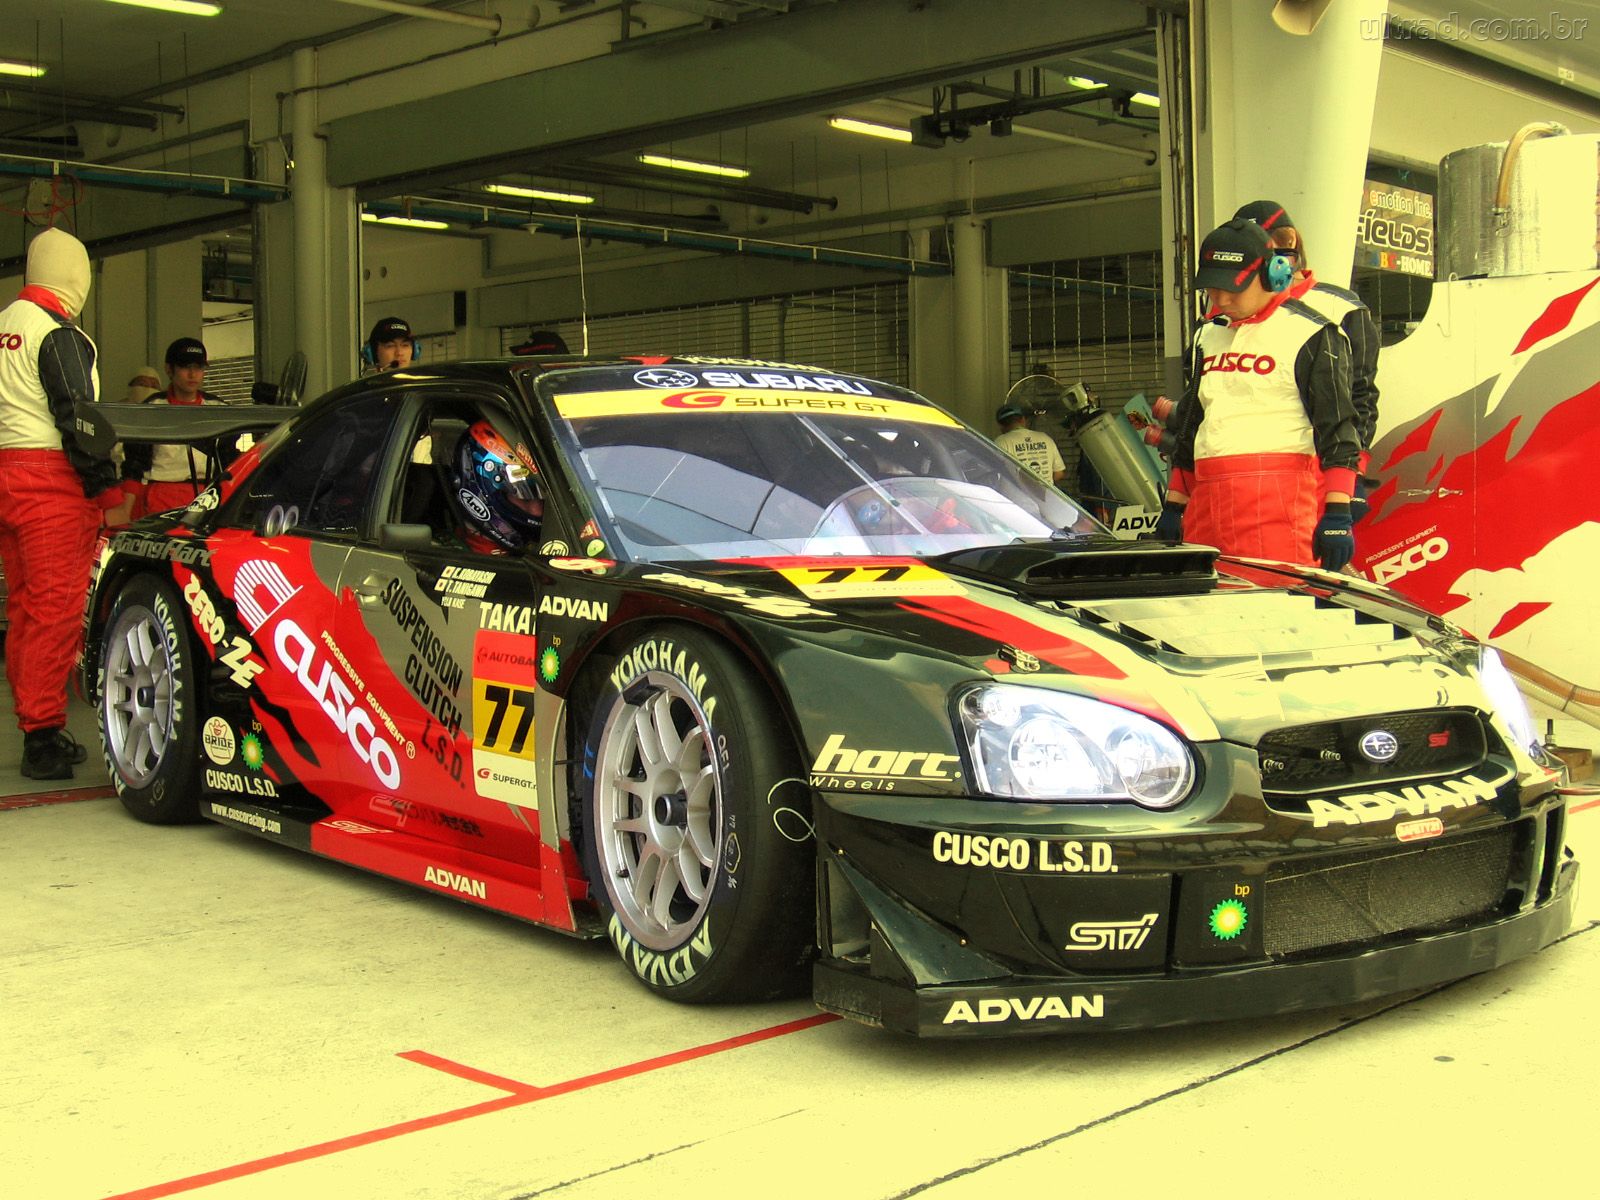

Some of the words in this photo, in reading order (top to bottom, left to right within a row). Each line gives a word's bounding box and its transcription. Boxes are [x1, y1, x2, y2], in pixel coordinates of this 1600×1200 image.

[1201, 352, 1276, 375] CUSCO
[702, 371, 872, 396] SUBARU
[736, 397, 847, 410] SUPER
[855, 402, 891, 412] GT
[461, 492, 487, 518] Arai
[808, 566, 912, 584] 77
[539, 595, 608, 622] ADVAN
[380, 577, 463, 698] SUSPENSION
[552, 635, 561, 647] bp
[321, 630, 366, 693] PROGRESSIVE
[366, 691, 406, 746] EQUIPMENT
[404, 653, 462, 741] CLUTCH
[610, 640, 717, 728] YOKOHAMA
[274, 619, 401, 790] CUSCO
[482, 684, 534, 753] 77
[205, 734, 233, 749] BRIDE
[252, 720, 262, 733] bp
[421, 719, 466, 789] L.S.D.
[206, 768, 244, 793] CUSCO
[244, 775, 280, 798] L.S.D.
[809, 775, 896, 791] Wheels
[1307, 775, 1498, 828] ADVAN
[211, 802, 281, 834] www.cuscoracing.com
[933, 831, 1031, 869] CUSCO
[1039, 840, 1119, 873] L.S.D.
[424, 866, 486, 900] ADVAN
[1235, 884, 1250, 897] bp
[608, 912, 713, 987] ADVAN
[943, 995, 1104, 1024] ADVAN
